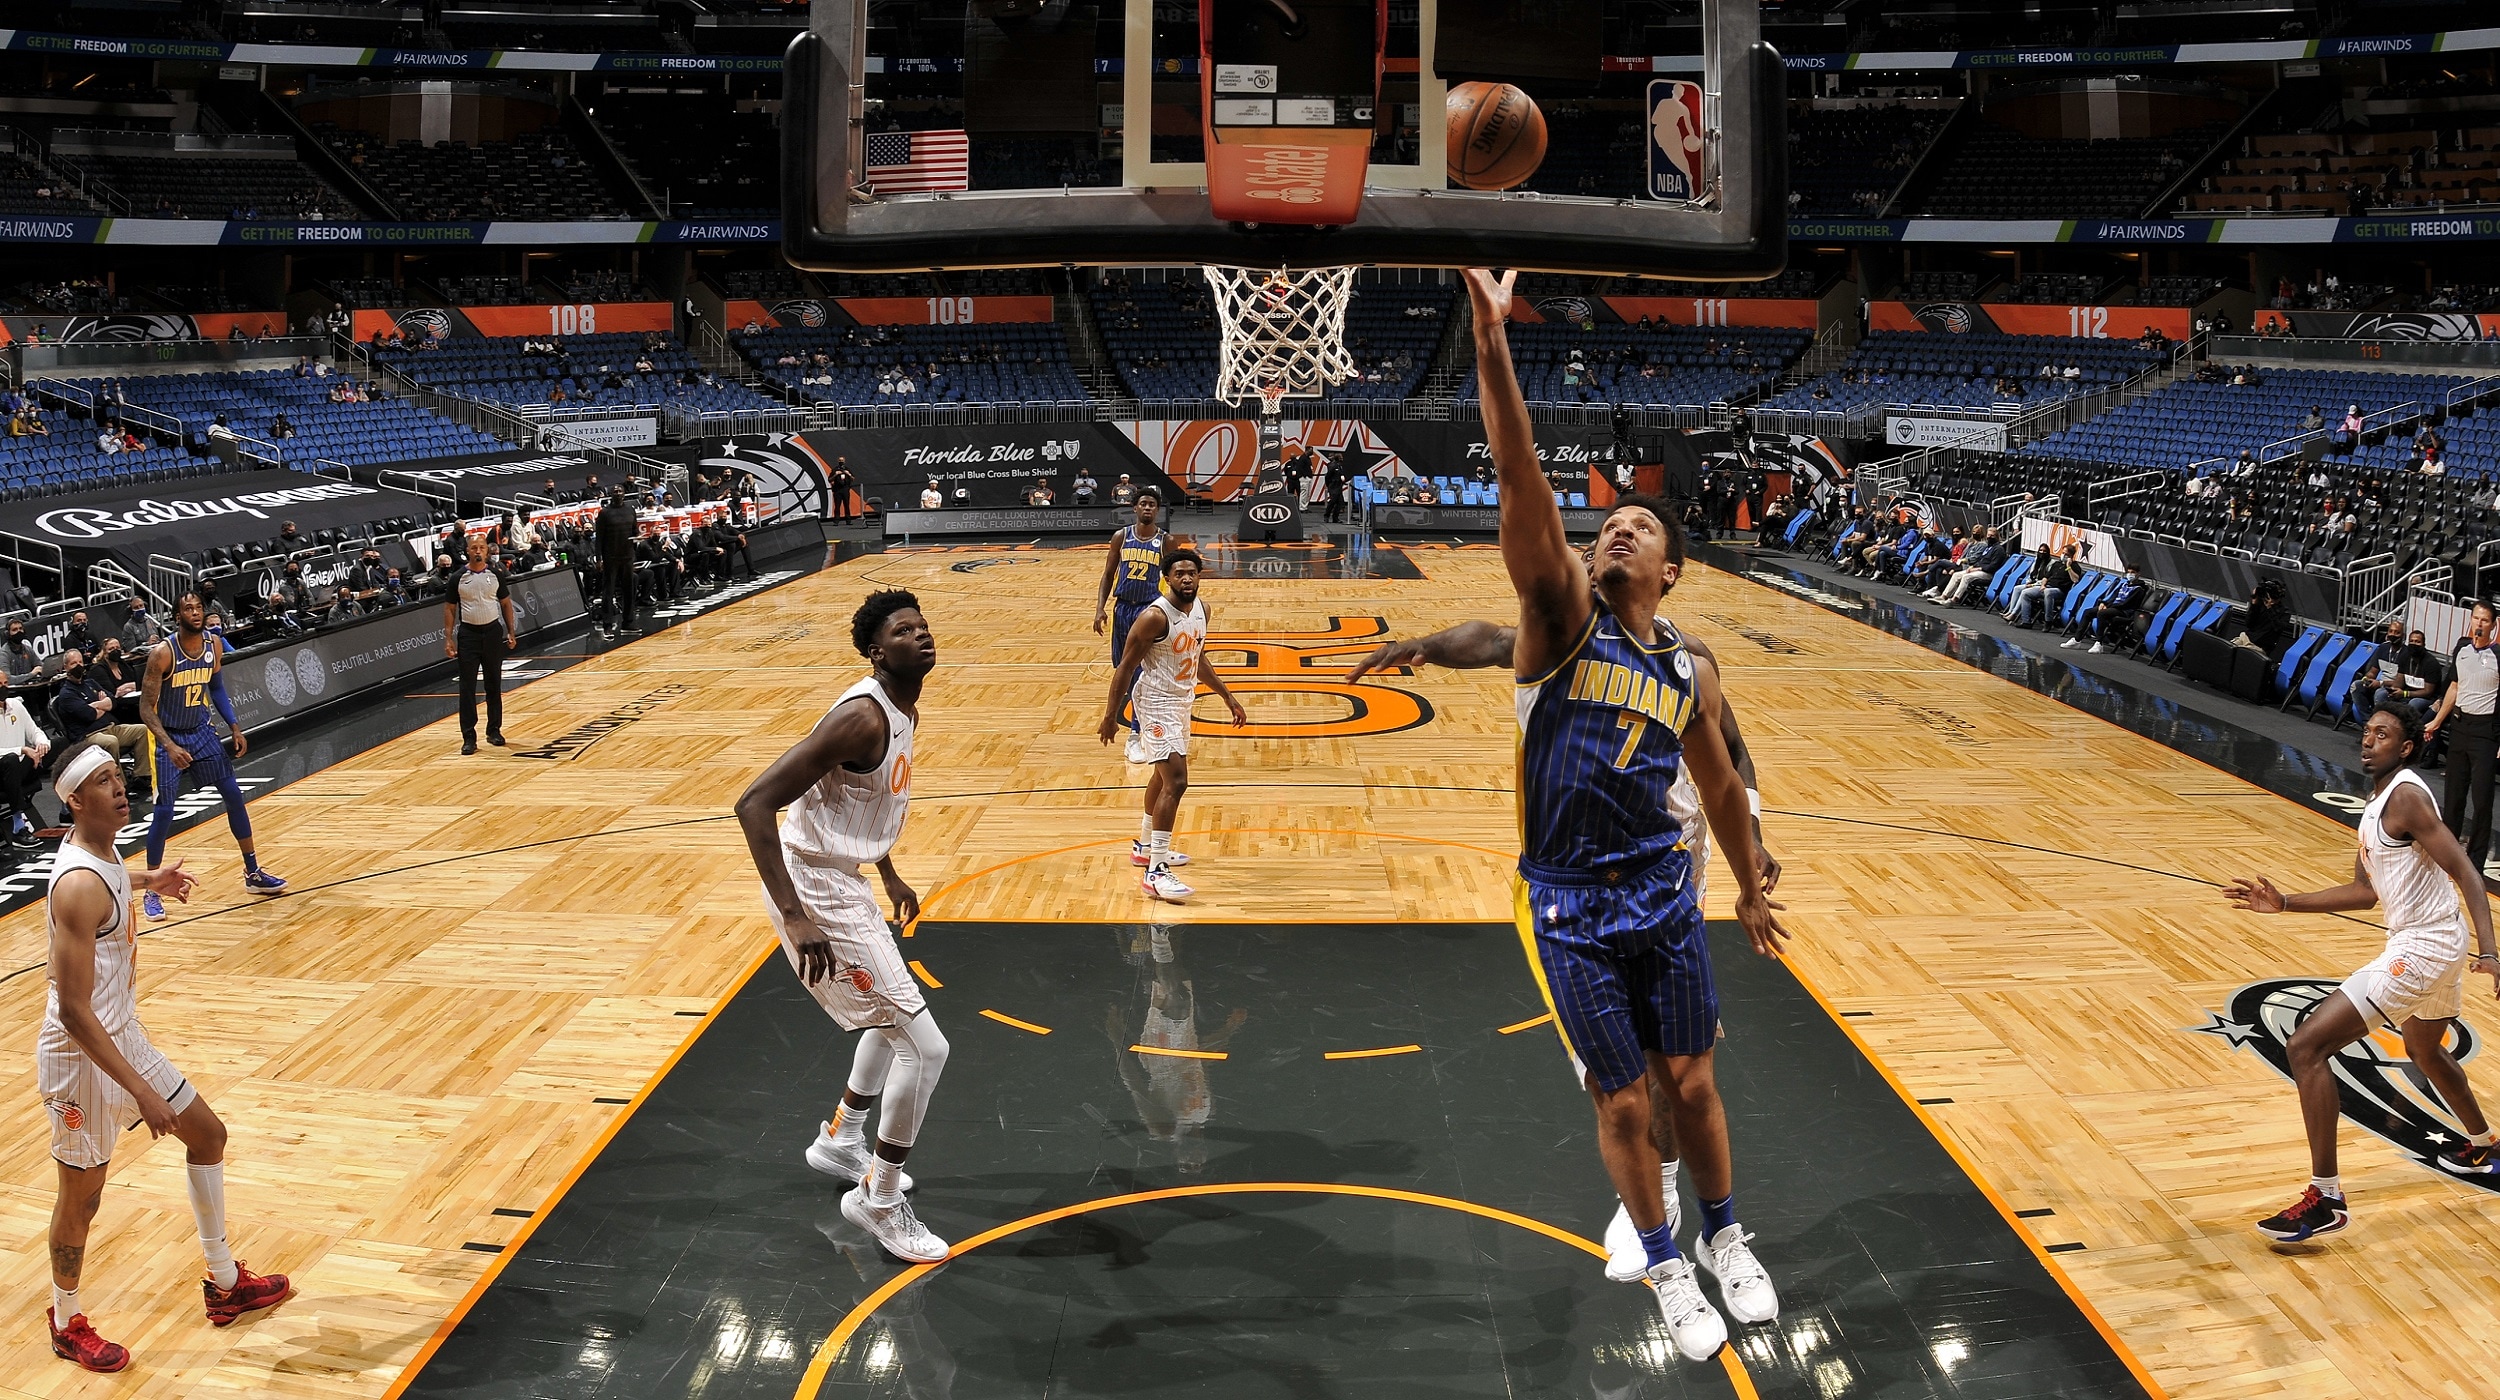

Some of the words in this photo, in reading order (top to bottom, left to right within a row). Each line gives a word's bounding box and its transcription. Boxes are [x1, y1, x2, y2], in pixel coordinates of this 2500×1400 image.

[26, 35, 48, 47] GET
[51, 36, 72, 49] THE
[73, 38, 127, 53] FREEDOM
[130, 42, 146, 54] TO
[147, 43, 166, 55] GO
[167, 44, 222, 57] FURTHER.
[2347, 38, 2412, 53] FAIRWINDS
[401, 53, 468, 65] FAIRWINDS
[612, 58, 635, 68] GET
[637, 58, 659, 68] THE
[661, 58, 716, 69] FREEDOM
[719, 59, 733, 69] TO
[736, 59, 754, 69] GO
[756, 60, 784, 69] FURT
[1970, 55, 1993, 65] GET
[1995, 54, 2016, 64] THE
[2018, 52, 2073, 64] FREEDOM
[2075, 52, 2091, 62] TO
[2093, 51, 2111, 62] GO
[2114, 50, 2168, 61] FURTHER.
[1101, 59, 1109, 72] 7
[1656, 173, 1683, 193] NBA
[240, 227, 265, 240] GET
[268, 227, 294, 240] THE
[297, 227, 362, 240] FREEDOM
[365, 227, 383, 240] TO
[386, 227, 406, 240] GO
[408, 227, 474, 240] FURTHER.
[690, 225, 769, 239] FAIRWINDS
[1804, 224, 1825, 236] GO
[1828, 225, 1893, 237] FURTHER.
[2109, 224, 2185, 239] FAIRWINDS
[2354, 223, 2380, 237] GET
[2382, 223, 2408, 237] THE
[2411, 220, 2472, 237] FREEDOM
[2475, 220, 2493, 235] TO
[926, 296, 974, 325] 109
[1693, 298, 1728, 328] 111
[549, 304, 595, 336] 108
[2068, 306, 2108, 339] 112
[156, 346, 176, 361] 107
[2361, 345, 2382, 359] 113
[574, 425, 640, 435] INTERNATIONAL
[903, 443, 984, 467] Florida
[987, 442, 1035, 463] Blue
[927, 472, 945, 481] Your
[947, 471, 966, 480] local
[967, 470, 985, 479] Blue
[987, 470, 1010, 479] Cross
[1011, 469, 1030, 478] Blue
[1031, 467, 1057, 477] Shield
[1575, 470, 1589, 479] Blu
[35, 497, 270, 538] Bally
[236, 482, 379, 509] SPORTS
[962, 512, 1003, 520] OFFICIAL
[1005, 511, 1042, 520] LUXURY
[1044, 510, 1082, 519] VEHICLE
[1256, 507, 1284, 519] KIA
[1441, 510, 1478, 518] WINTER
[1480, 510, 1501, 518] PAR
[945, 520, 988, 530] CENTRAL
[989, 520, 1029, 529] FLORIDA
[1031, 519, 1055, 528] BMW
[1056, 518, 1100, 528] CENTERS
[1480, 519, 1500, 527] FIEL
[1121, 548, 1160, 566] INDIANA
[1126, 561, 1149, 581] 22
[396, 630, 438, 653] RESPONSIBLY
[185, 685, 202, 708] 12
[1568, 659, 1693, 738] INDIANA
[1613, 710, 1648, 769] 7
